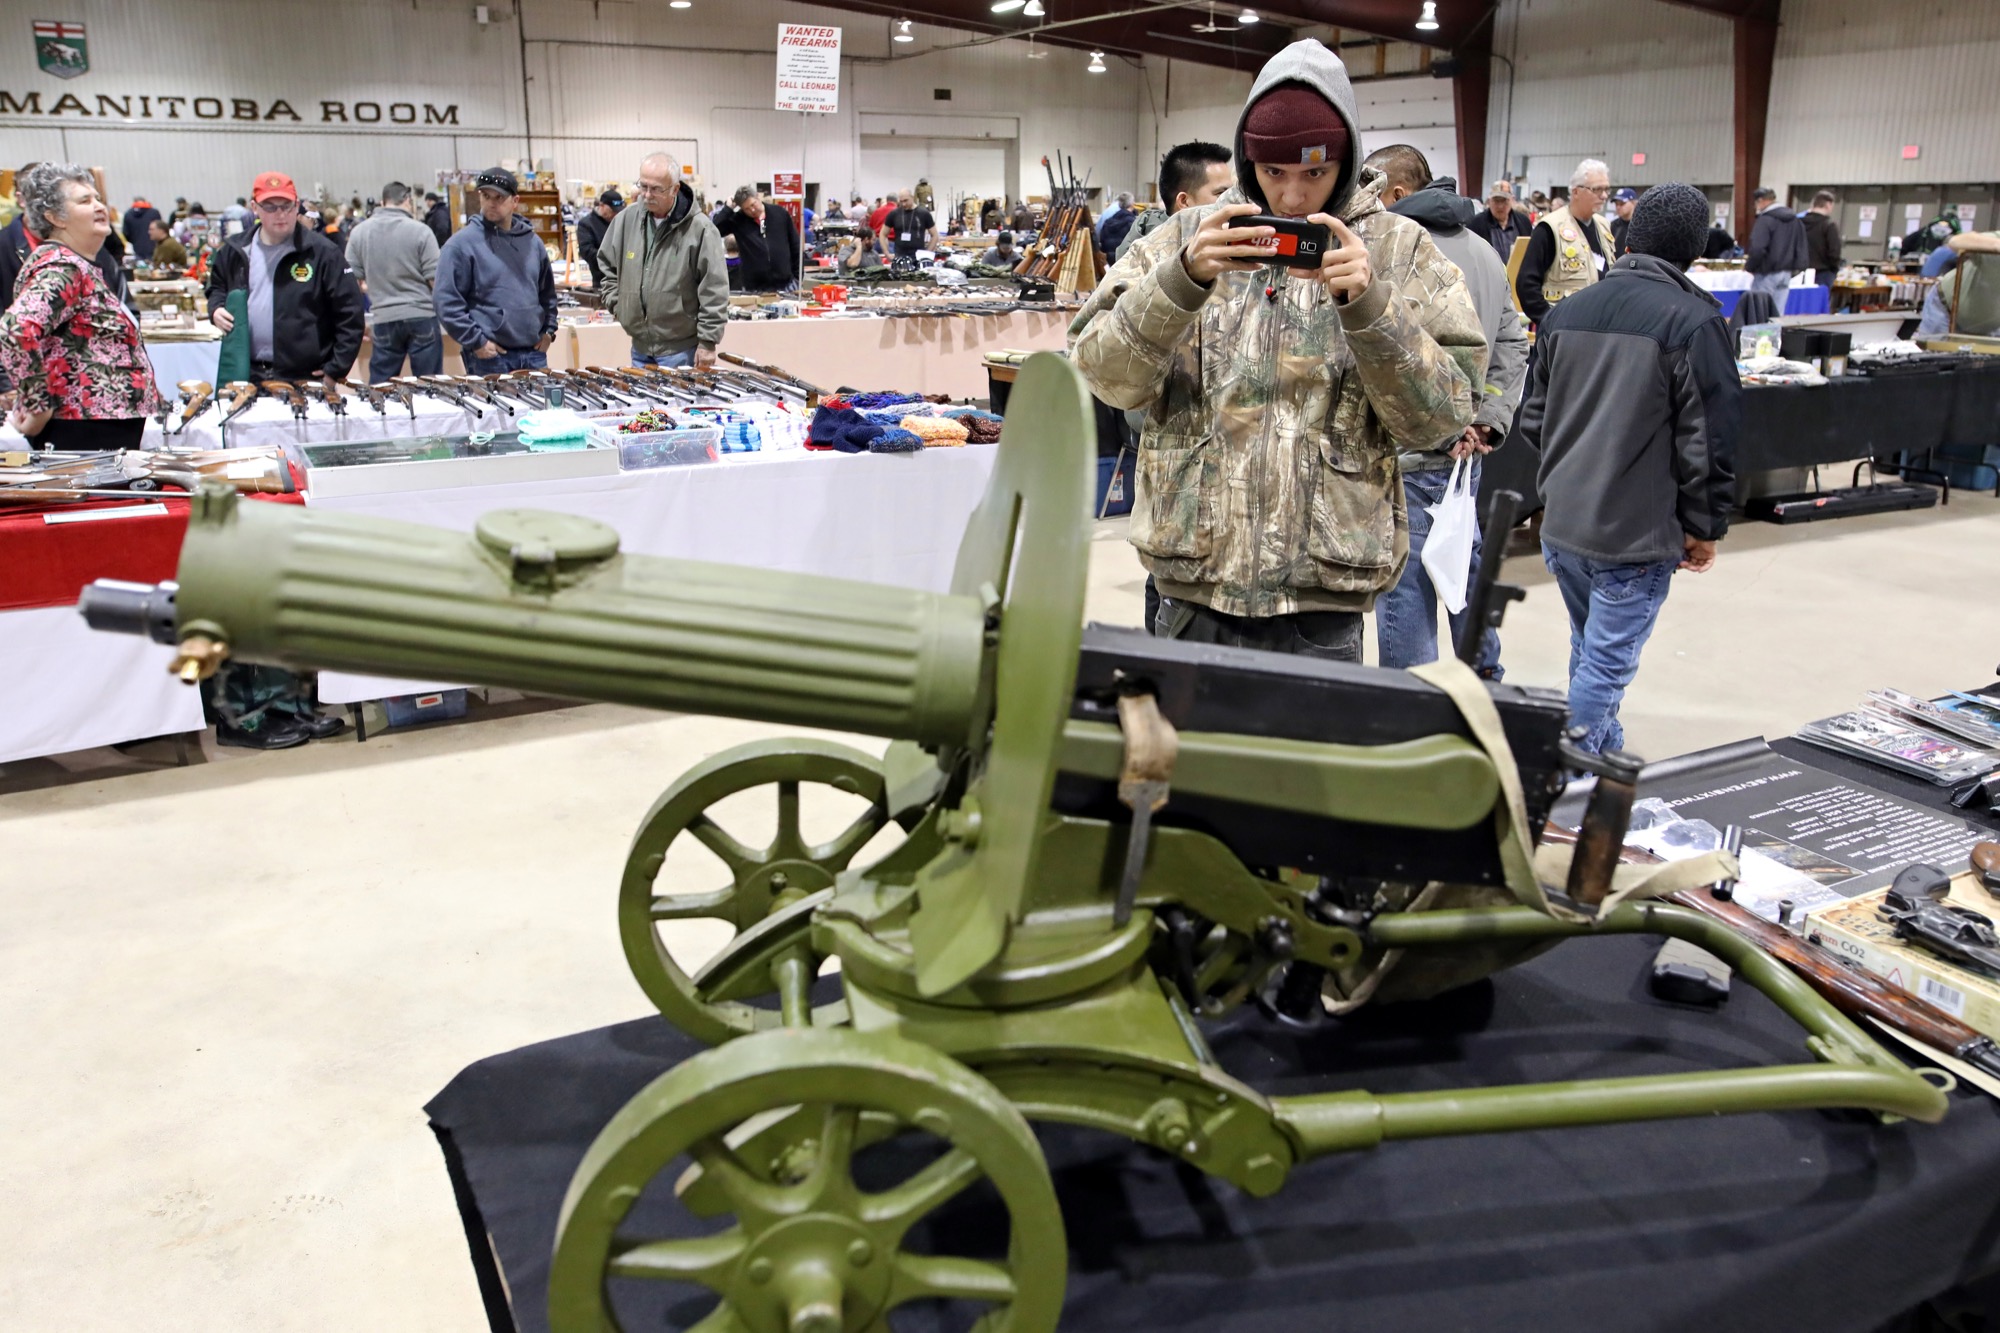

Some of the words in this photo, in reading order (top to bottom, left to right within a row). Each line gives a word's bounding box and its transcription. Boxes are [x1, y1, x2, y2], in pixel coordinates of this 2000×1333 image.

[786, 26, 834, 37] WANTED
[781, 37, 838, 48] FIREARMS
[779, 80, 798, 89] CALL
[801, 82, 836, 91] LEONARD
[0, 91, 301, 121] MANITOBA
[320, 101, 459, 125] ROOM
[1777, 794, 1813, 806] WARRANTY
[1787, 816, 1818, 828] AIRCRAFT
[1825, 813, 1855, 823] WITHOUT
[1794, 821, 1824, 832] FAILURE
[1841, 941, 1865, 958] CO2
